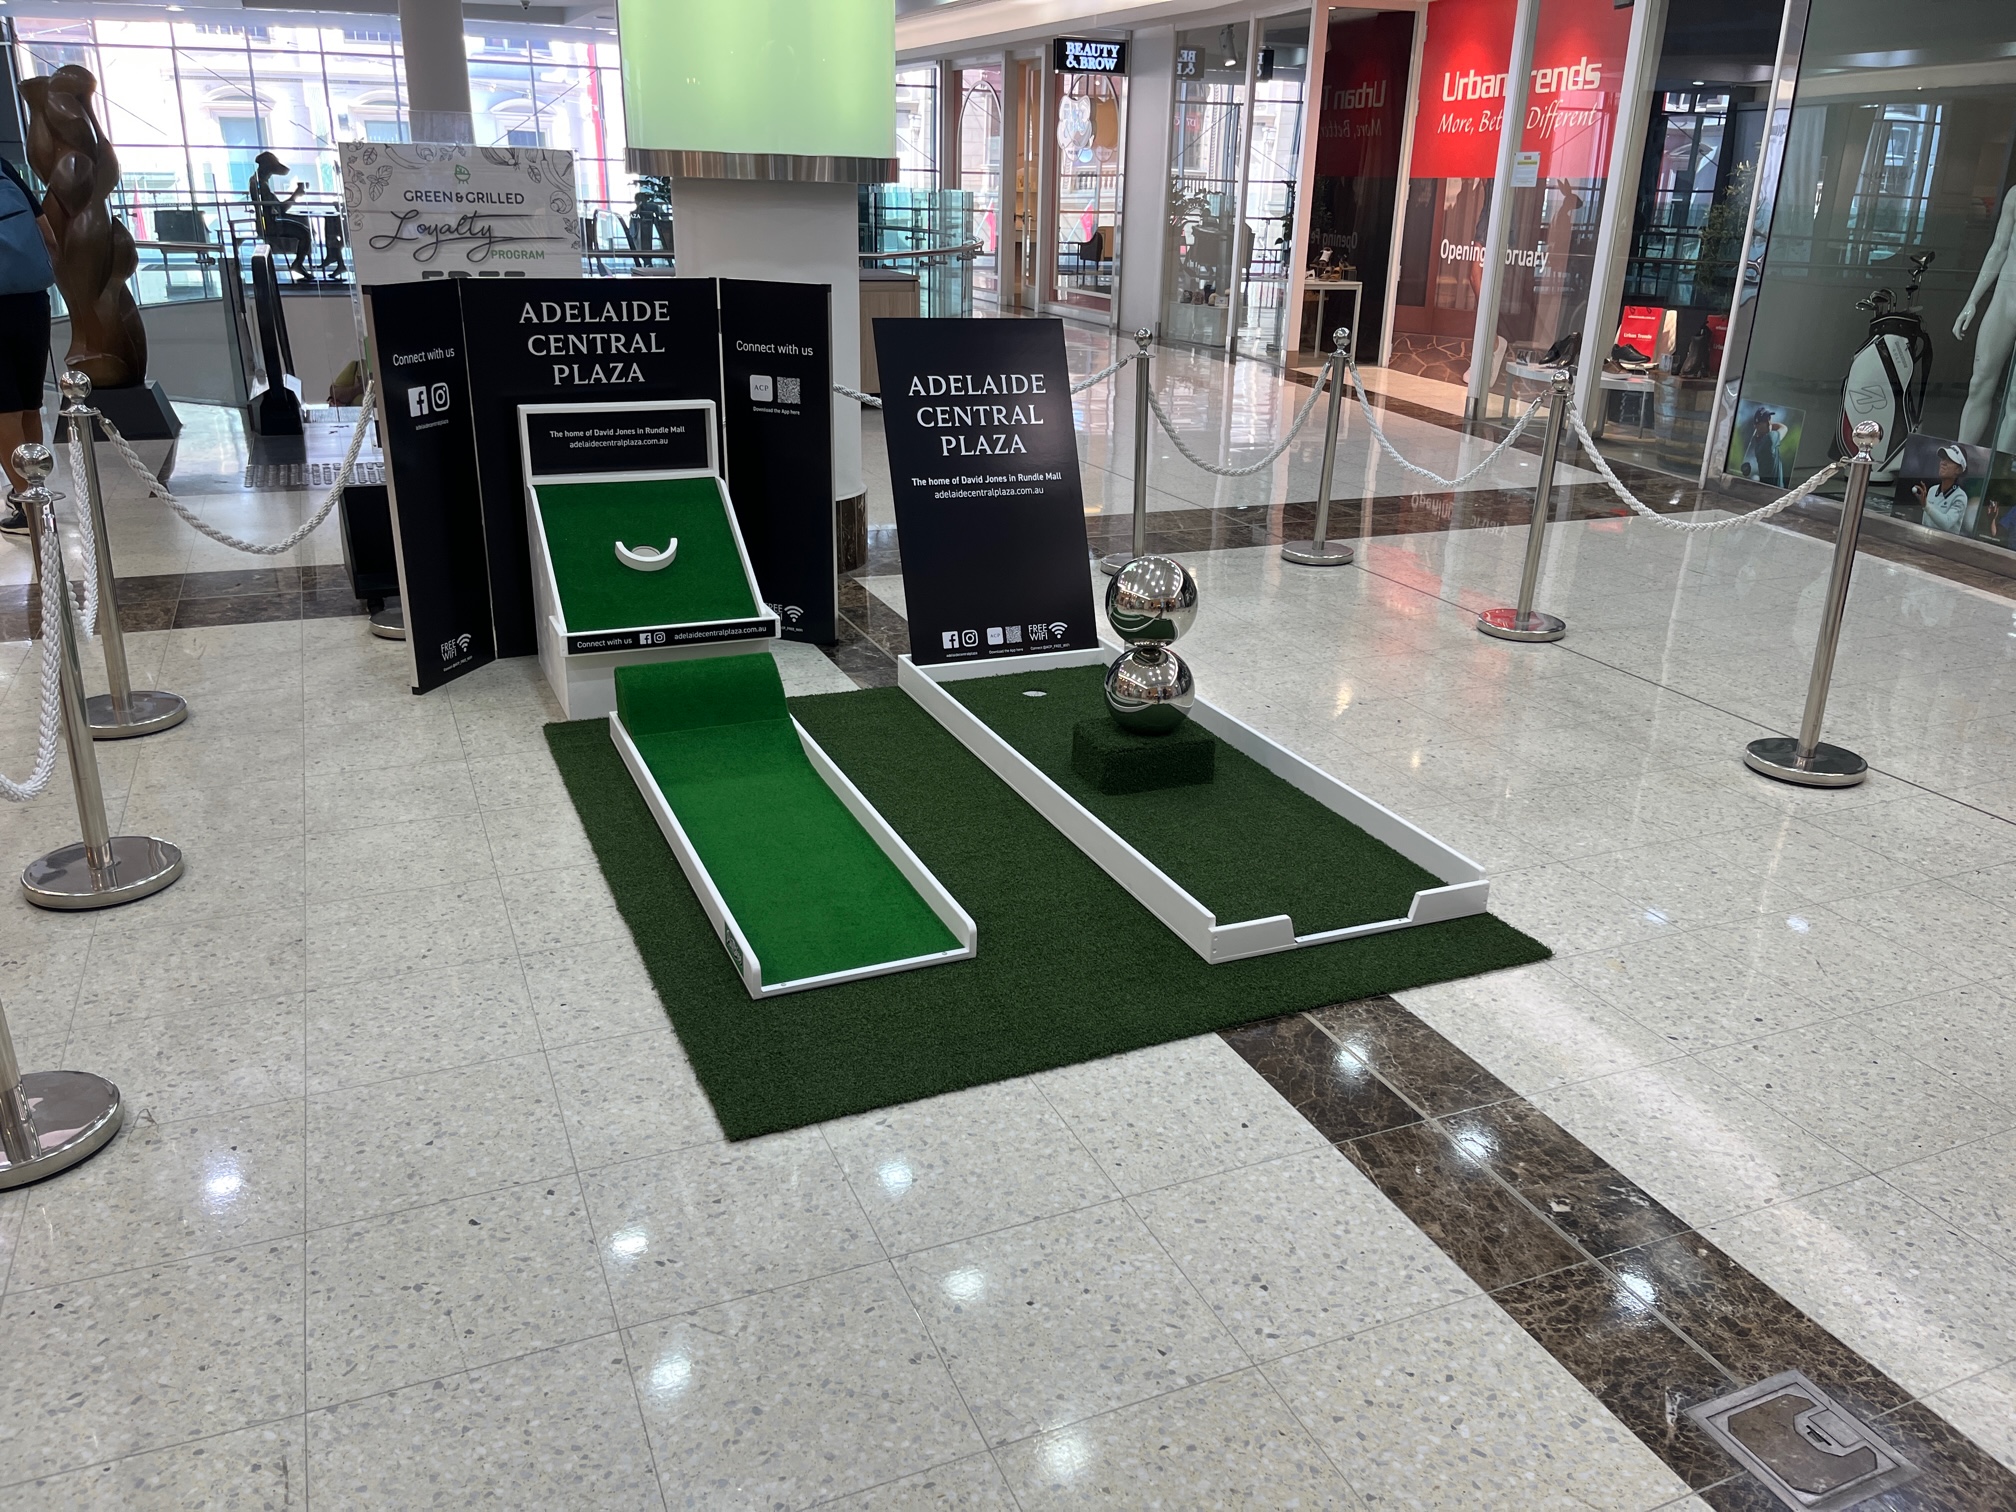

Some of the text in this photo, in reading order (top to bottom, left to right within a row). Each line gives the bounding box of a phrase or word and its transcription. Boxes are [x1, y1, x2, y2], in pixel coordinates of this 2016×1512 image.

[1065, 41, 1120, 58] BEAUTY
[1080, 56, 1118, 71] BROW
[1442, 56, 1602, 102] Urban ends
[1437, 112, 1475, 135] More,
[1526, 99, 1598, 140] Different
[403, 189, 525, 205] GREEN & GRILLED
[369, 209, 567, 263] Loyalty
[490, 250, 545, 260] PROGRAM
[1504, 244, 1549, 274] bruary
[519, 300, 671, 324] ADELAIDE
[527, 332, 666, 356] CENTRAL
[736, 340, 814, 356] Connect with us
[392, 347, 455, 367] Connect with us
[552, 362, 646, 386] PLAZA
[908, 373, 1047, 396] ADELAIDE
[916, 404, 1044, 428] CENTRAL
[549, 430, 563, 438] The
[564, 430, 584, 438] home
[585, 429, 593, 437] of
[594, 428, 614, 436] David
[615, 428, 636, 436] Jones
[637, 427, 646, 435] in
[647, 426, 669, 434] Rundle
[569, 438, 669, 448] adelaidecentralplaza.com.au
[940, 433, 1027, 456] PLAZA
[911, 471, 1062, 487] The home of David Jones in Rundle Mall
[934, 488, 1044, 499] adelaidecentralplaza.com.au
[1028, 623, 1048, 633] FREE
[1028, 631, 1048, 641] WIFI
[440, 638, 457, 654] FREE
[576, 626, 767, 649] Connect with us adelaidecentralplaza.com.au
